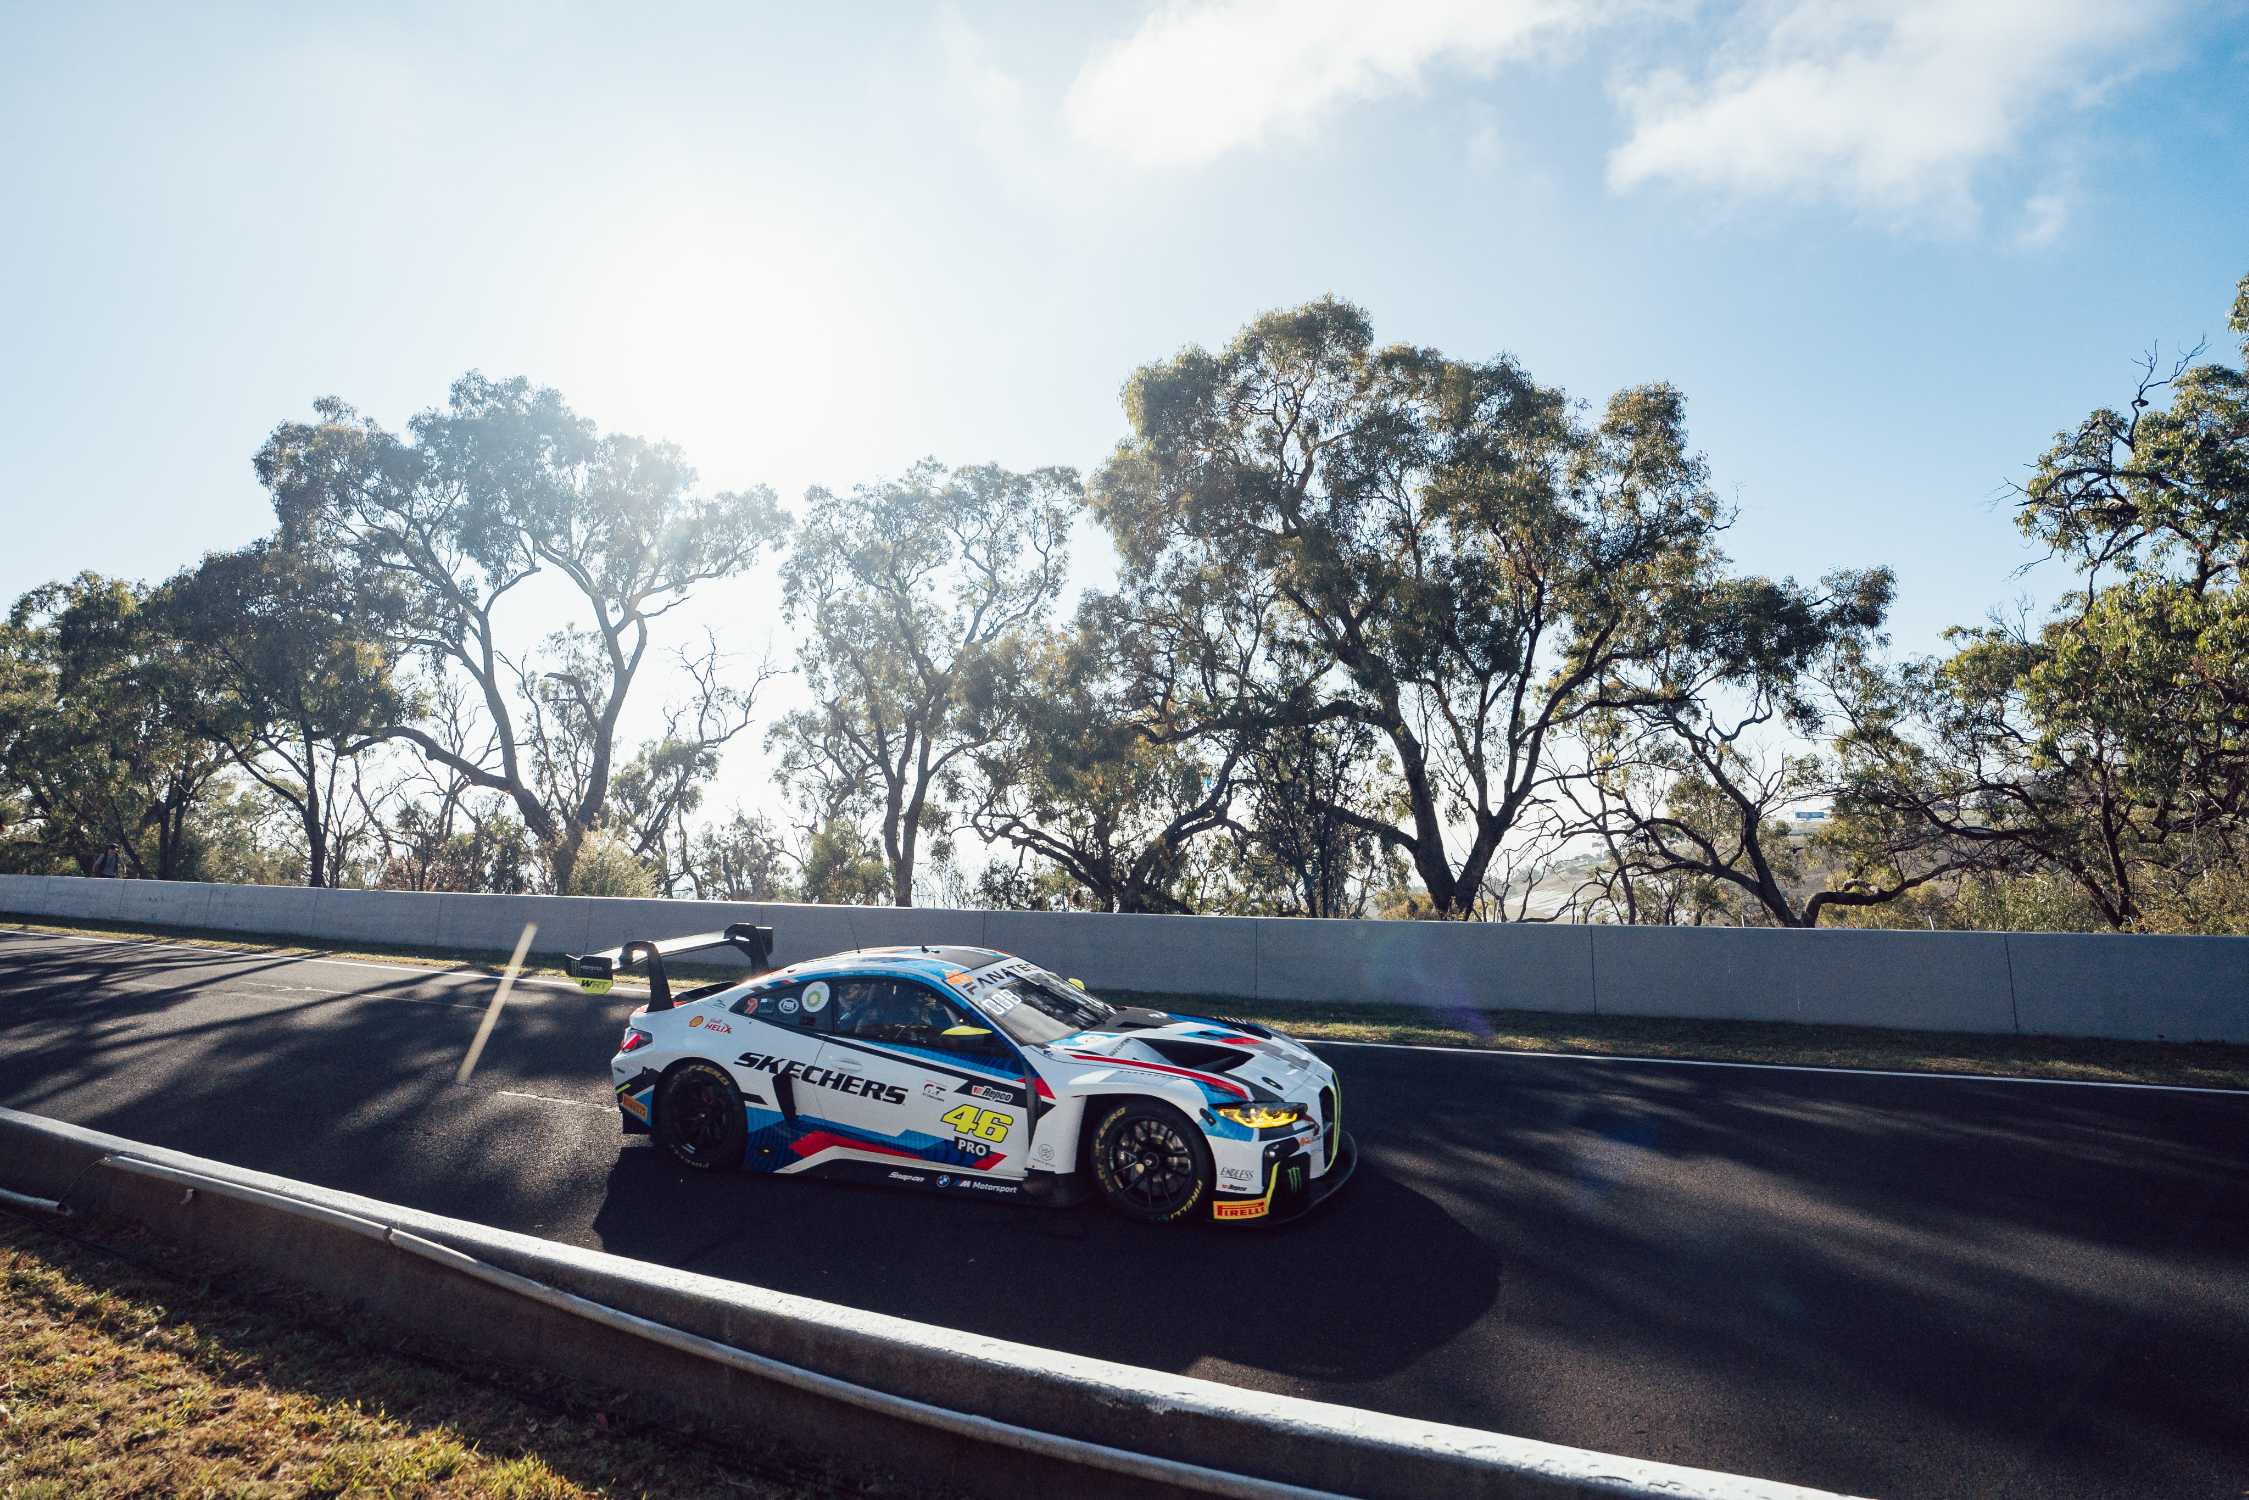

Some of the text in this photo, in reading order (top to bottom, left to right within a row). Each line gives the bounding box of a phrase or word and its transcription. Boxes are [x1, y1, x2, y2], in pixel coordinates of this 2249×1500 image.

[703, 1023, 734, 1035] HELIX
[733, 1051, 910, 1105] SKECHERS
[982, 1086, 1014, 1103] Repco
[941, 1103, 1014, 1144] 46
[957, 1138, 987, 1157] PRO
[1220, 1167, 1254, 1179] ENDLESS
[971, 1180, 1018, 1194] Motorsport
[1170, 1179, 1204, 1221] PIRELLI
[1216, 1201, 1265, 1217] PIRELLI
